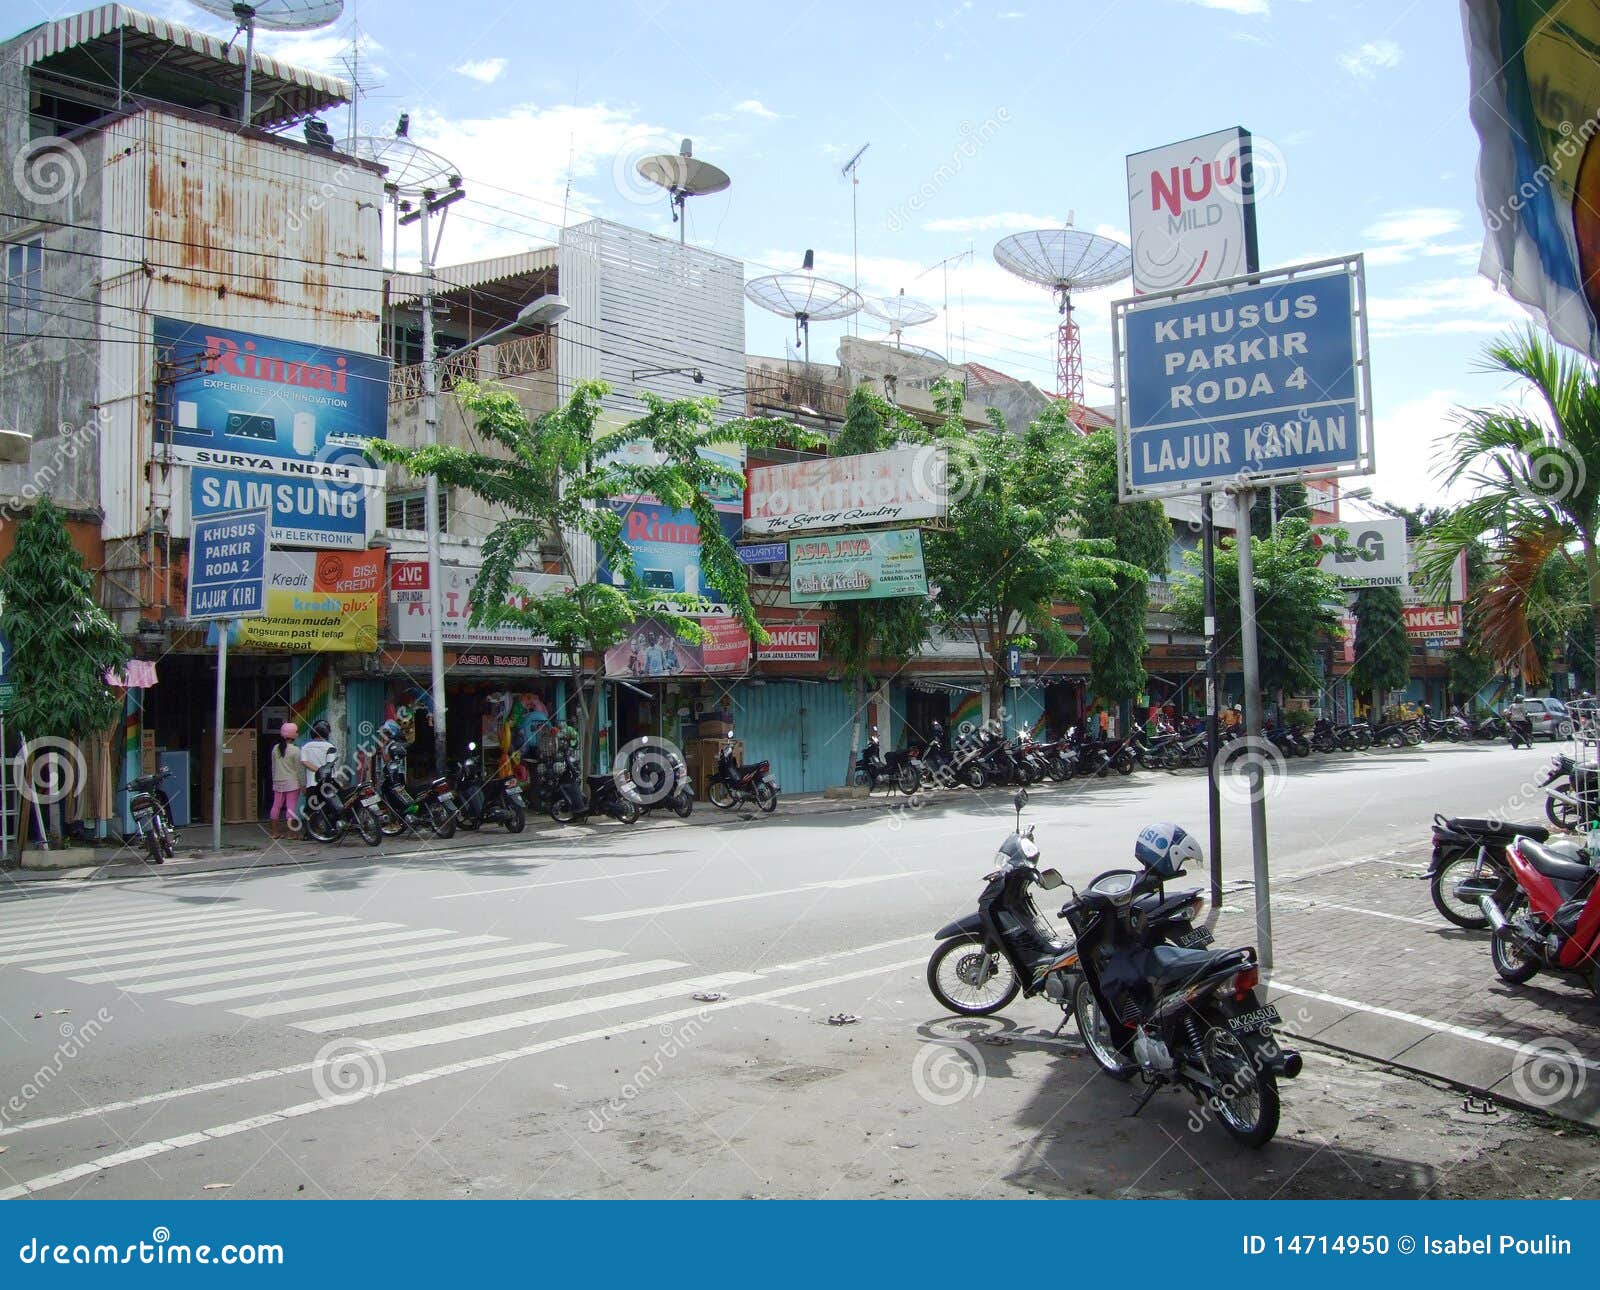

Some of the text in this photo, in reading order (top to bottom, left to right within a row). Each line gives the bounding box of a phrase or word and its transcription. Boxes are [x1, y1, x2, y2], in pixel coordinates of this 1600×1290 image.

[1167, 203, 1223, 236] MILD
[1155, 294, 1318, 343] KHUSUS
[1165, 331, 1308, 376] PARKIR
[204, 335, 348, 394] Rinnai
[203, 378, 267, 397] EXPERIENCE
[291, 391, 349, 408] INNOVATION
[1170, 365, 1308, 409] RODA 4
[1143, 415, 1347, 474] LAJUR KANAN
[196, 451, 351, 479] SURYA INDAH
[201, 476, 359, 519] SAMSUNG
[843, 505, 903, 520] Quality
[203, 523, 256, 542] KHUSUS
[286, 531, 354, 545] ELEKTRONIK
[628, 511, 702, 545] Rinn
[205, 541, 251, 559] PARKIR
[794, 538, 872, 561] ASIA JAYA
[1334, 530, 1385, 564] LG
[205, 560, 250, 577] RODA 2
[352, 564, 378, 579] BISA
[398, 566, 422, 582] JVC
[271, 573, 309, 587] Kredit
[335, 577, 377, 593] KREDIT
[794, 574, 819, 592] Cash
[832, 570, 869, 590] Kredit
[195, 586, 257, 610] LAJUR KIRI
[302, 616, 341, 627] mudah
[1402, 610, 1458, 627] ANKEN
[247, 626, 290, 639] angsuran
[290, 627, 319, 640] pasti
[769, 631, 817, 646] ANKEN
[458, 655, 528, 666] ASIA BARU
